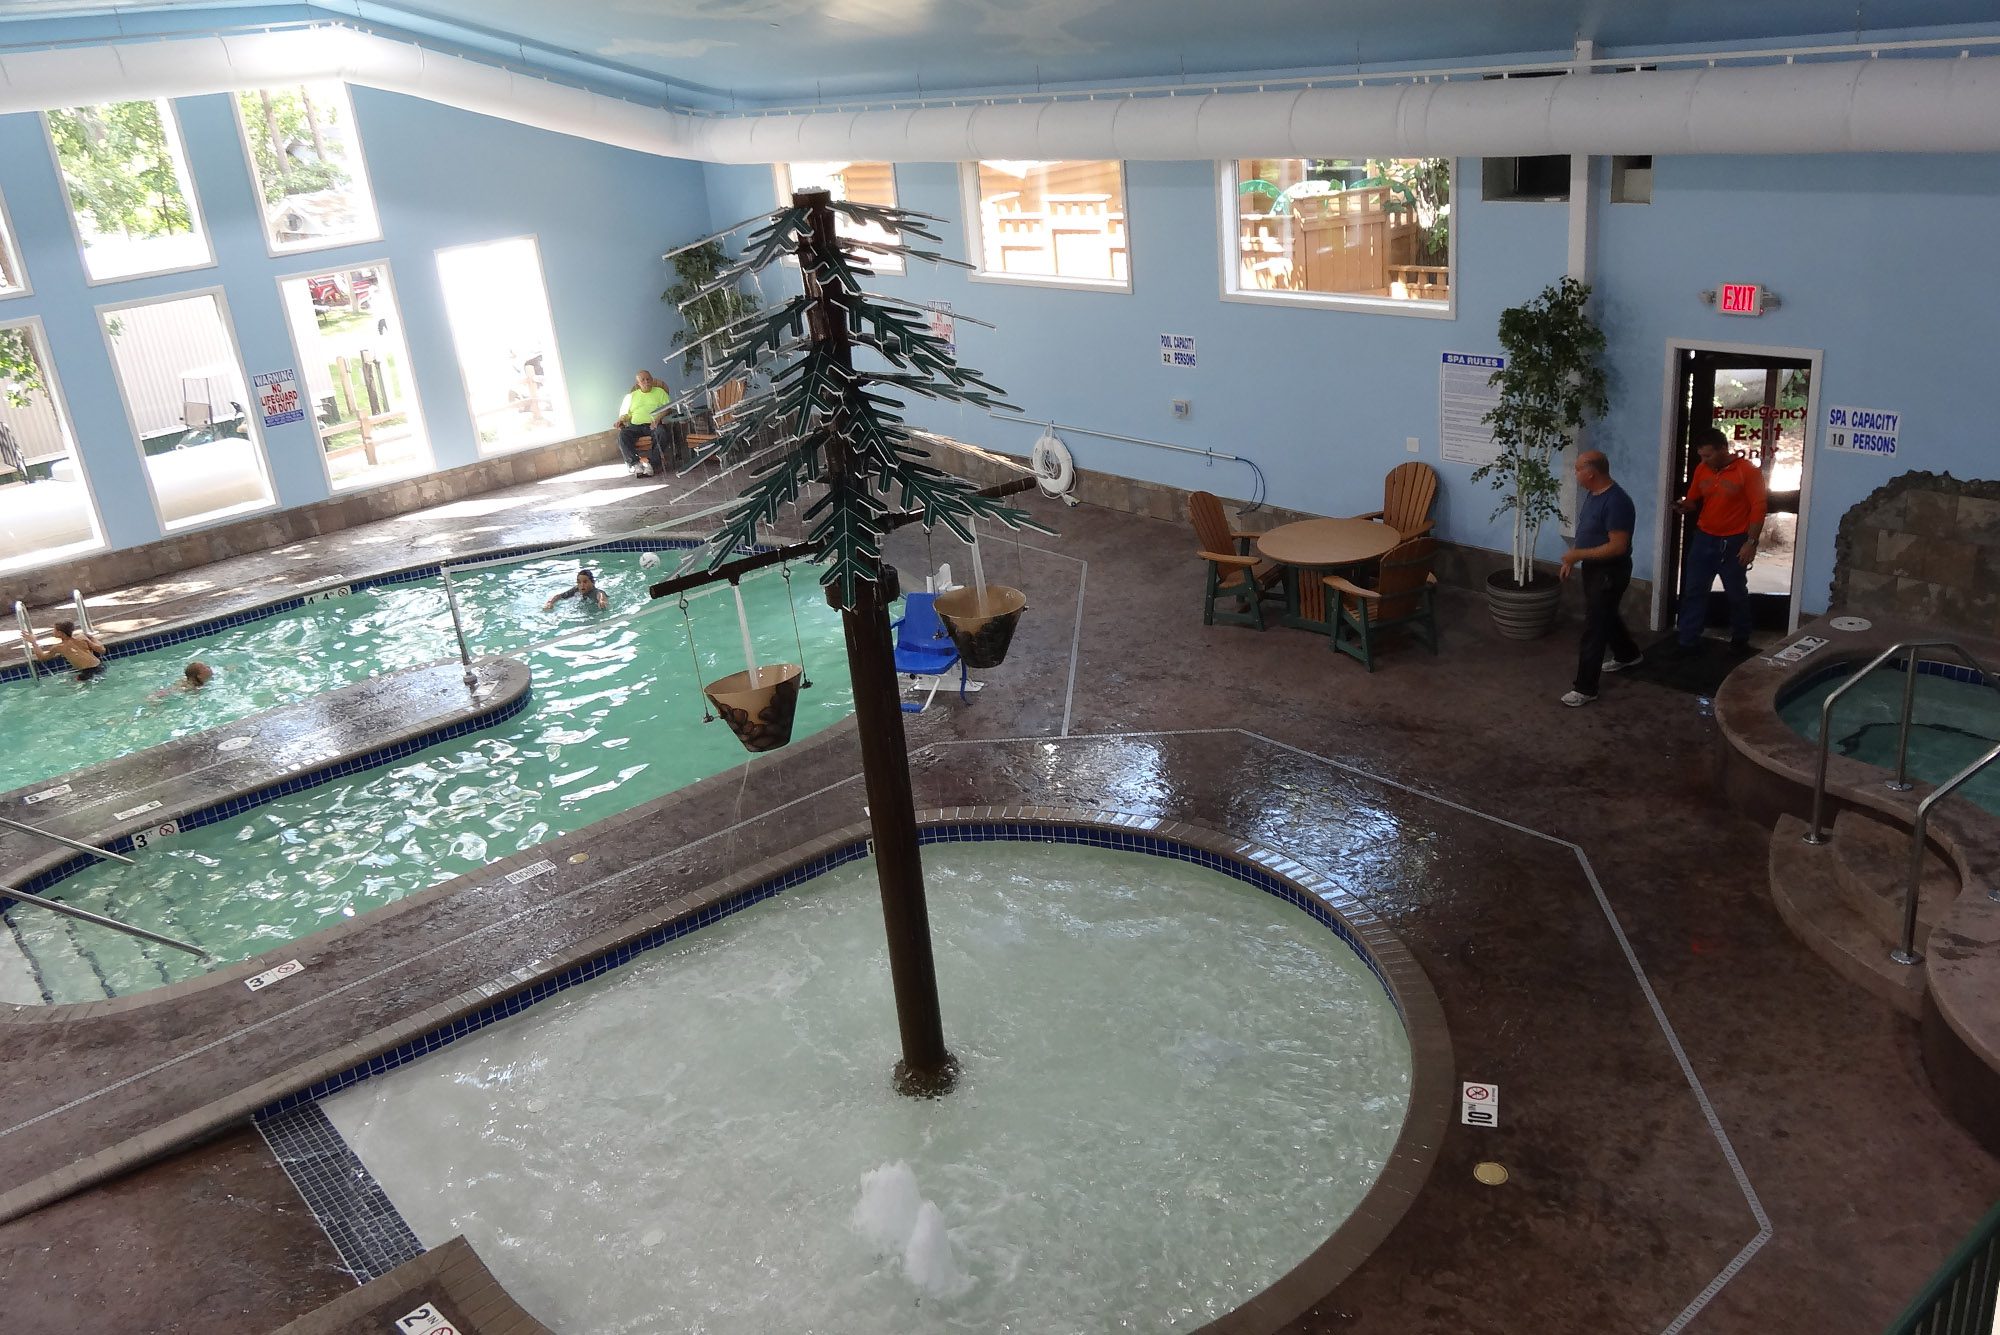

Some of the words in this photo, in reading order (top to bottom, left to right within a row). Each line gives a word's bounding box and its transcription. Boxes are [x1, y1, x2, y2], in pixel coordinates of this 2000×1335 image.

[1723, 285, 1756, 311] EXIT
[1161, 335, 1173, 348] POOL
[1173, 336, 1195, 350] CAPACITY
[1174, 352, 1196, 366] PERSONS
[1447, 355, 1465, 364] SPA
[1467, 357, 1498, 367] RULES
[255, 370, 294, 386] WARNING
[271, 384, 282, 394] NO
[260, 391, 298, 407] LIFEGUARD
[267, 405, 278, 415] ON
[277, 401, 296, 413] DUTY
[1713, 406, 1807, 420] Emergency
[1829, 409, 1846, 426] SPA
[1851, 411, 1898, 431] CAPACITY
[1733, 423, 1784, 440] Exit
[1832, 433, 1845, 446] 10
[1852, 433, 1896, 453] PERSONS
[135, 834, 148, 848] 3
[530, 861, 554, 875] BELOW
[249, 977, 264, 988] 3
[1467, 1111, 1493, 1125] 10
[403, 1309, 430, 1328] 2
[427, 1315, 439, 1325] IN
